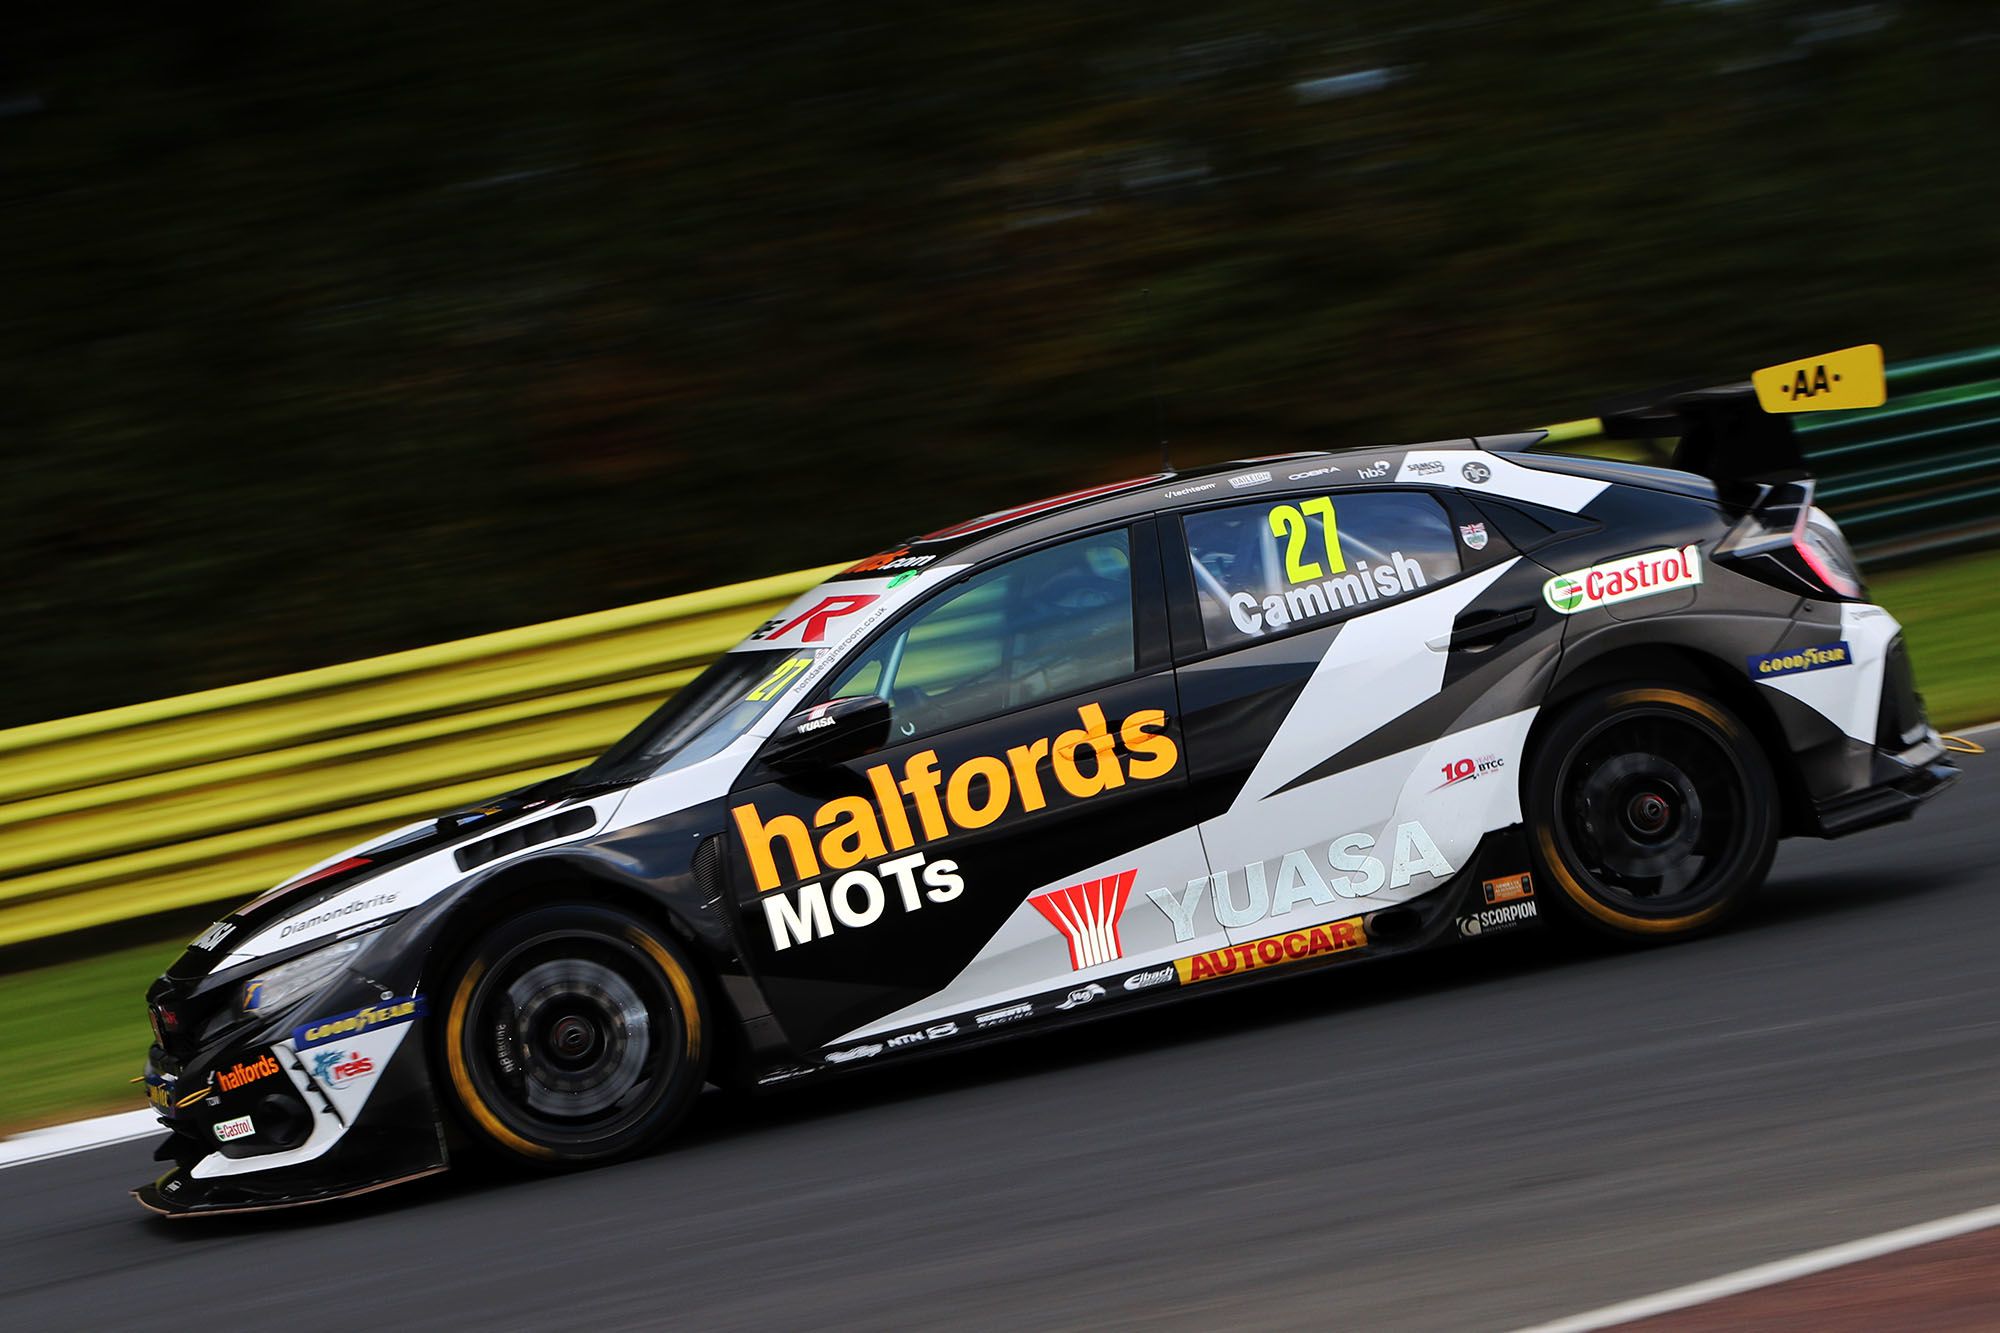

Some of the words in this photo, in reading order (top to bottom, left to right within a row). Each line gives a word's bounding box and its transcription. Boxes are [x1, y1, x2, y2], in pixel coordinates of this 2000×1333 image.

[1288, 466, 1341, 481] COBRA
[1358, 466, 1387, 479] hbs
[1268, 496, 1347, 585] 27
[1229, 551, 1427, 635] Cammish
[1585, 551, 1692, 601] Castrol
[793, 607, 888, 693] hondaengineroom.co.uk
[1759, 648, 1846, 673] GOODYEAR
[745, 658, 814, 701] 27
[797, 716, 836, 733] YUASA
[1478, 758, 1504, 771] BTCC
[732, 702, 1179, 893] halfords
[762, 852, 965, 952] MOTs
[1146, 820, 1456, 943] YUASA
[280, 892, 397, 940] Diamondbrite
[1480, 900, 1538, 927] SCORPION
[1190, 922, 1358, 981] AUTOCAR
[304, 1001, 416, 1041] GOODYEAR
[216, 1055, 279, 1092] halfords
[333, 1052, 374, 1080] reis
[223, 1119, 253, 1138] Castrol
